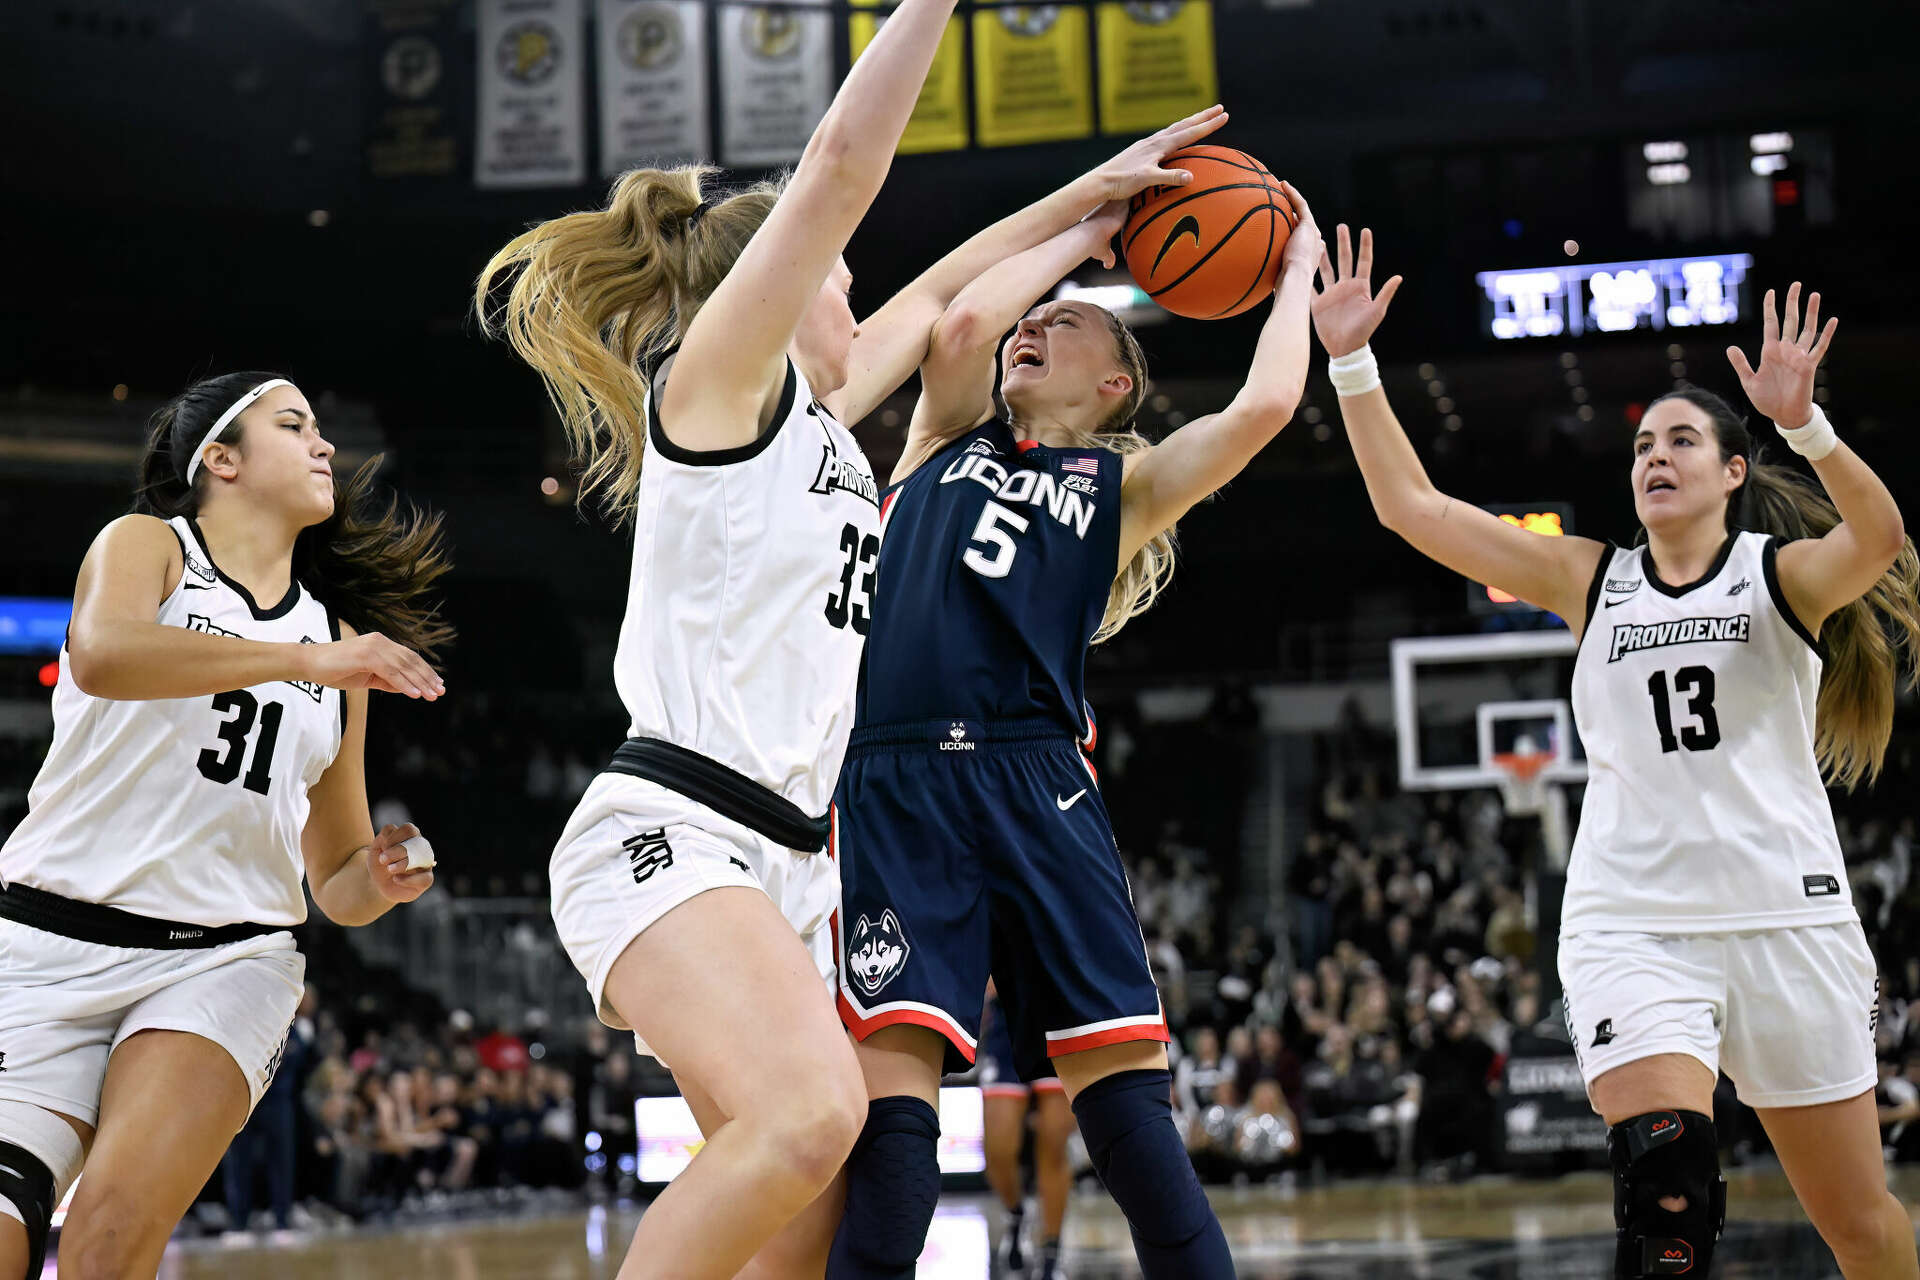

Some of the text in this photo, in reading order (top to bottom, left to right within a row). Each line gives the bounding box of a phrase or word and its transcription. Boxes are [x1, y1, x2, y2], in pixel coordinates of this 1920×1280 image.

[939, 454, 1096, 540] UCONN
[963, 500, 1030, 578] 5
[825, 522, 880, 636] 33
[1607, 614, 1751, 664] PROVIDENCE
[197, 689, 284, 796] 31
[940, 741, 975, 751] UCONN
[1647, 664, 1721, 754] 13
